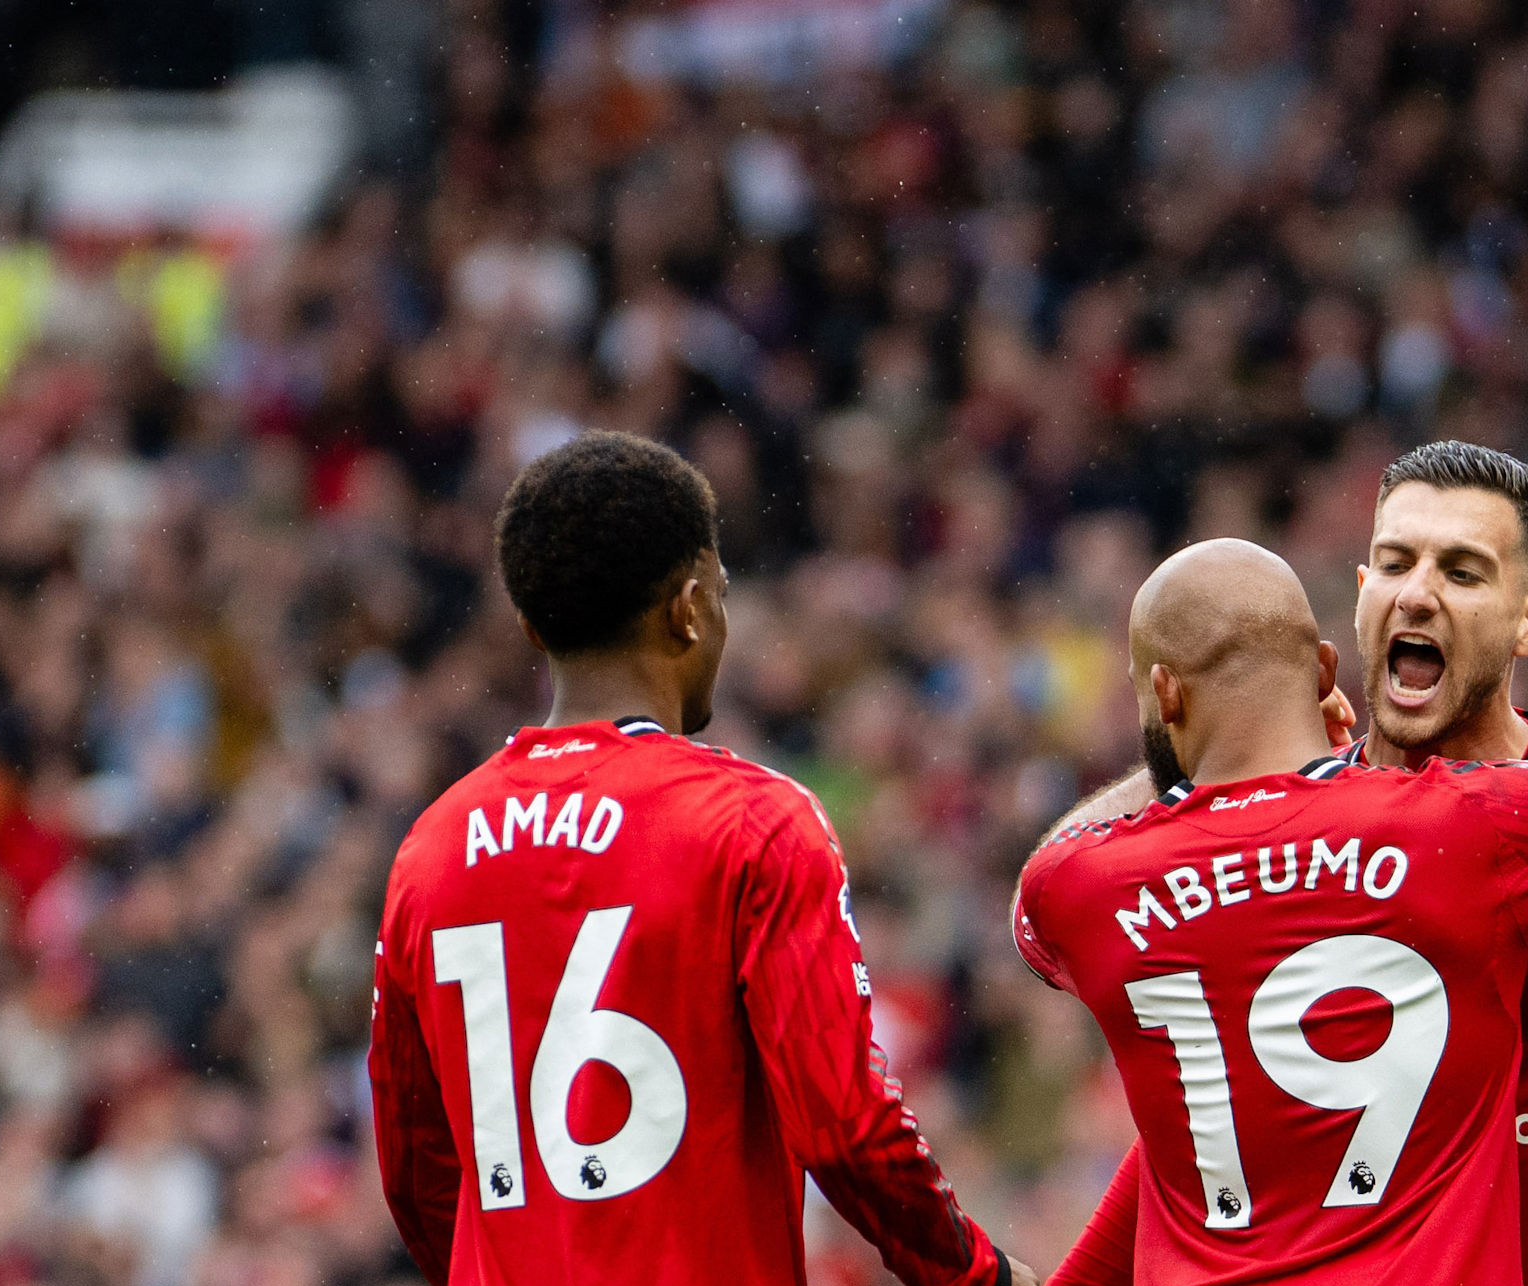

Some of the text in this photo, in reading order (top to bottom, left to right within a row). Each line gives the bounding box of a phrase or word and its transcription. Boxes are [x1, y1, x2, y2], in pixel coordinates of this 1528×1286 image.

[465, 791, 624, 867] AMAD
[1114, 837, 1409, 952] MBEUMO
[431, 905, 687, 1211] 16
[1124, 934, 1449, 1229] 19
